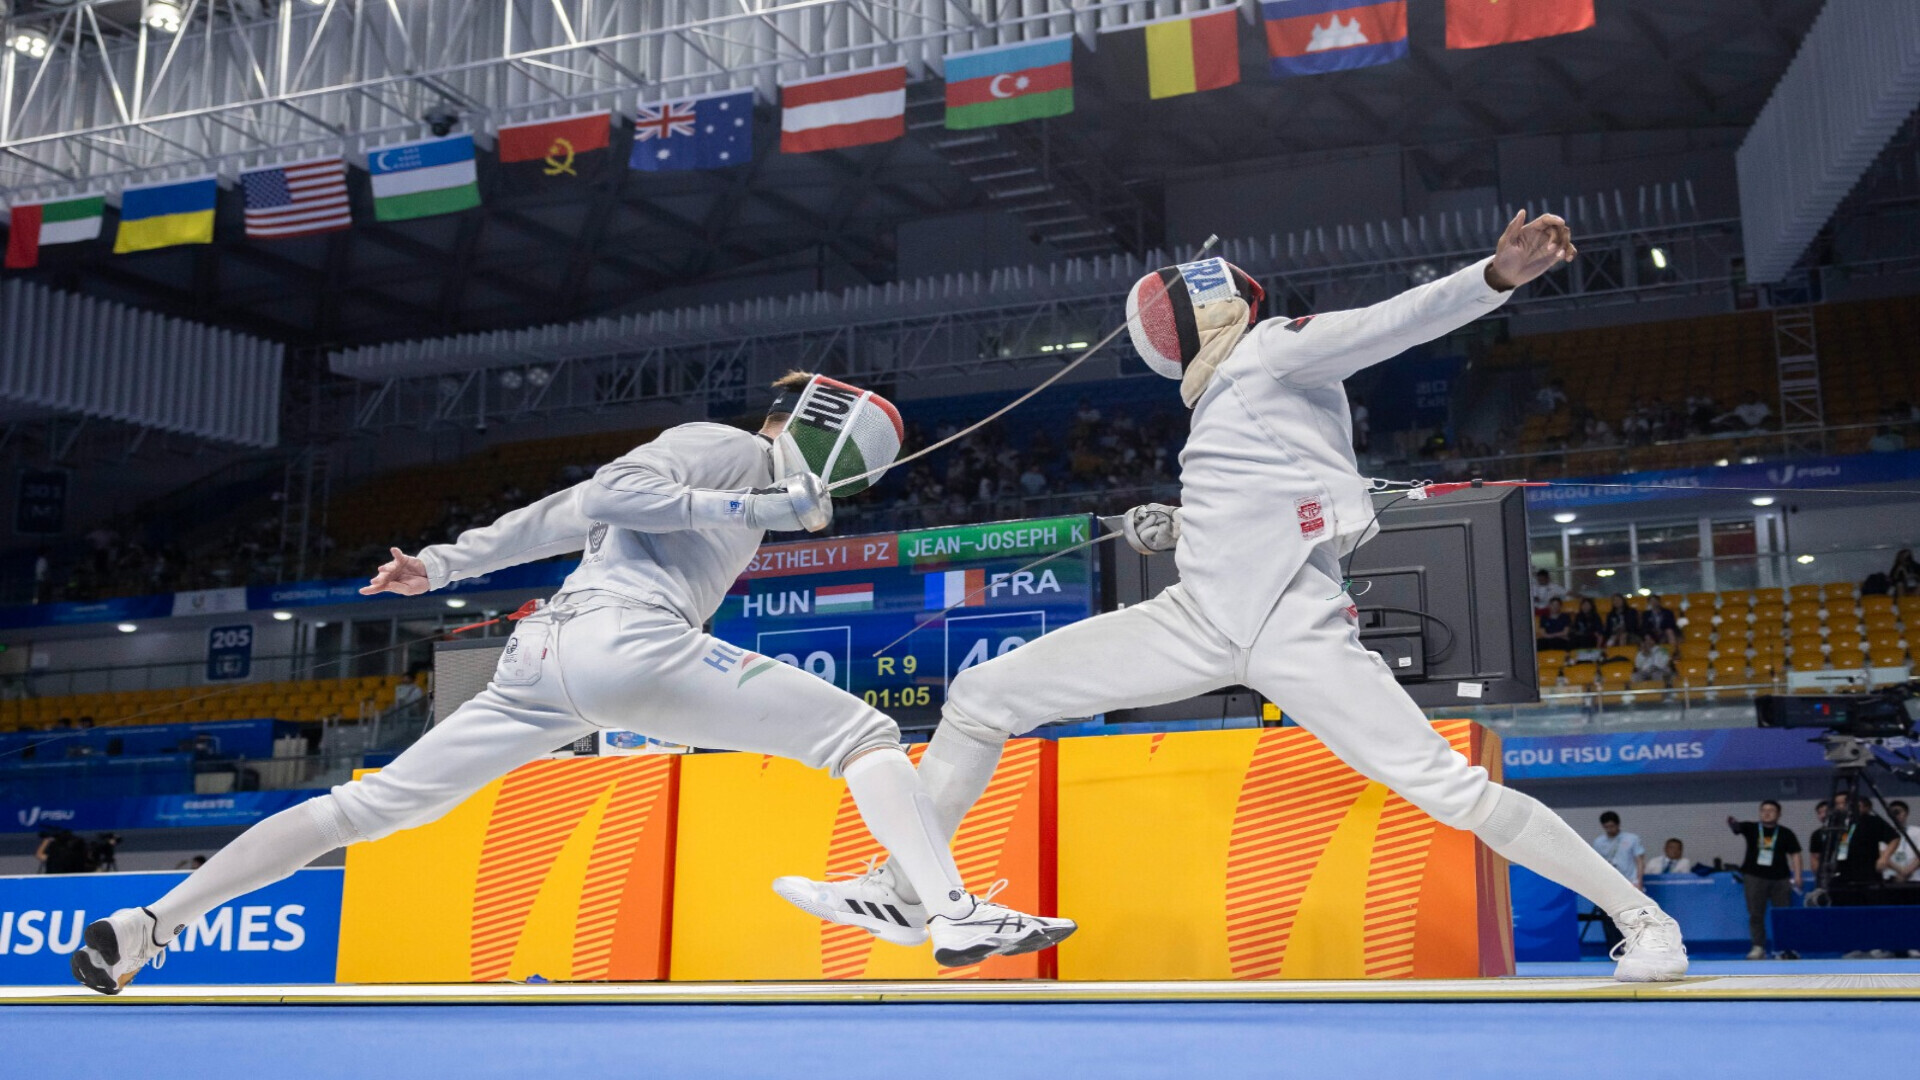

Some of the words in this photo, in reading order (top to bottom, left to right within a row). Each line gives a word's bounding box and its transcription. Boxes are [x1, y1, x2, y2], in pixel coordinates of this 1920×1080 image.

[799, 383, 860, 433] HUN
[908, 526, 1057, 558] JEAN-JOSEPH
[1070, 524, 1085, 543] K
[743, 546, 847, 573] SZTHELYI
[863, 542, 889, 562] PZ
[990, 569, 1062, 598] FRA
[742, 589, 810, 618] HUN
[212, 629, 251, 649] 205
[878, 657, 896, 676] R
[903, 655, 917, 674] 9
[864, 686, 930, 708] 01:05
[1505, 749, 1553, 766] GDU
[1560, 746, 1612, 763] FISU
[1619, 742, 1704, 761] GAMES
[112, 904, 306, 952] MES
